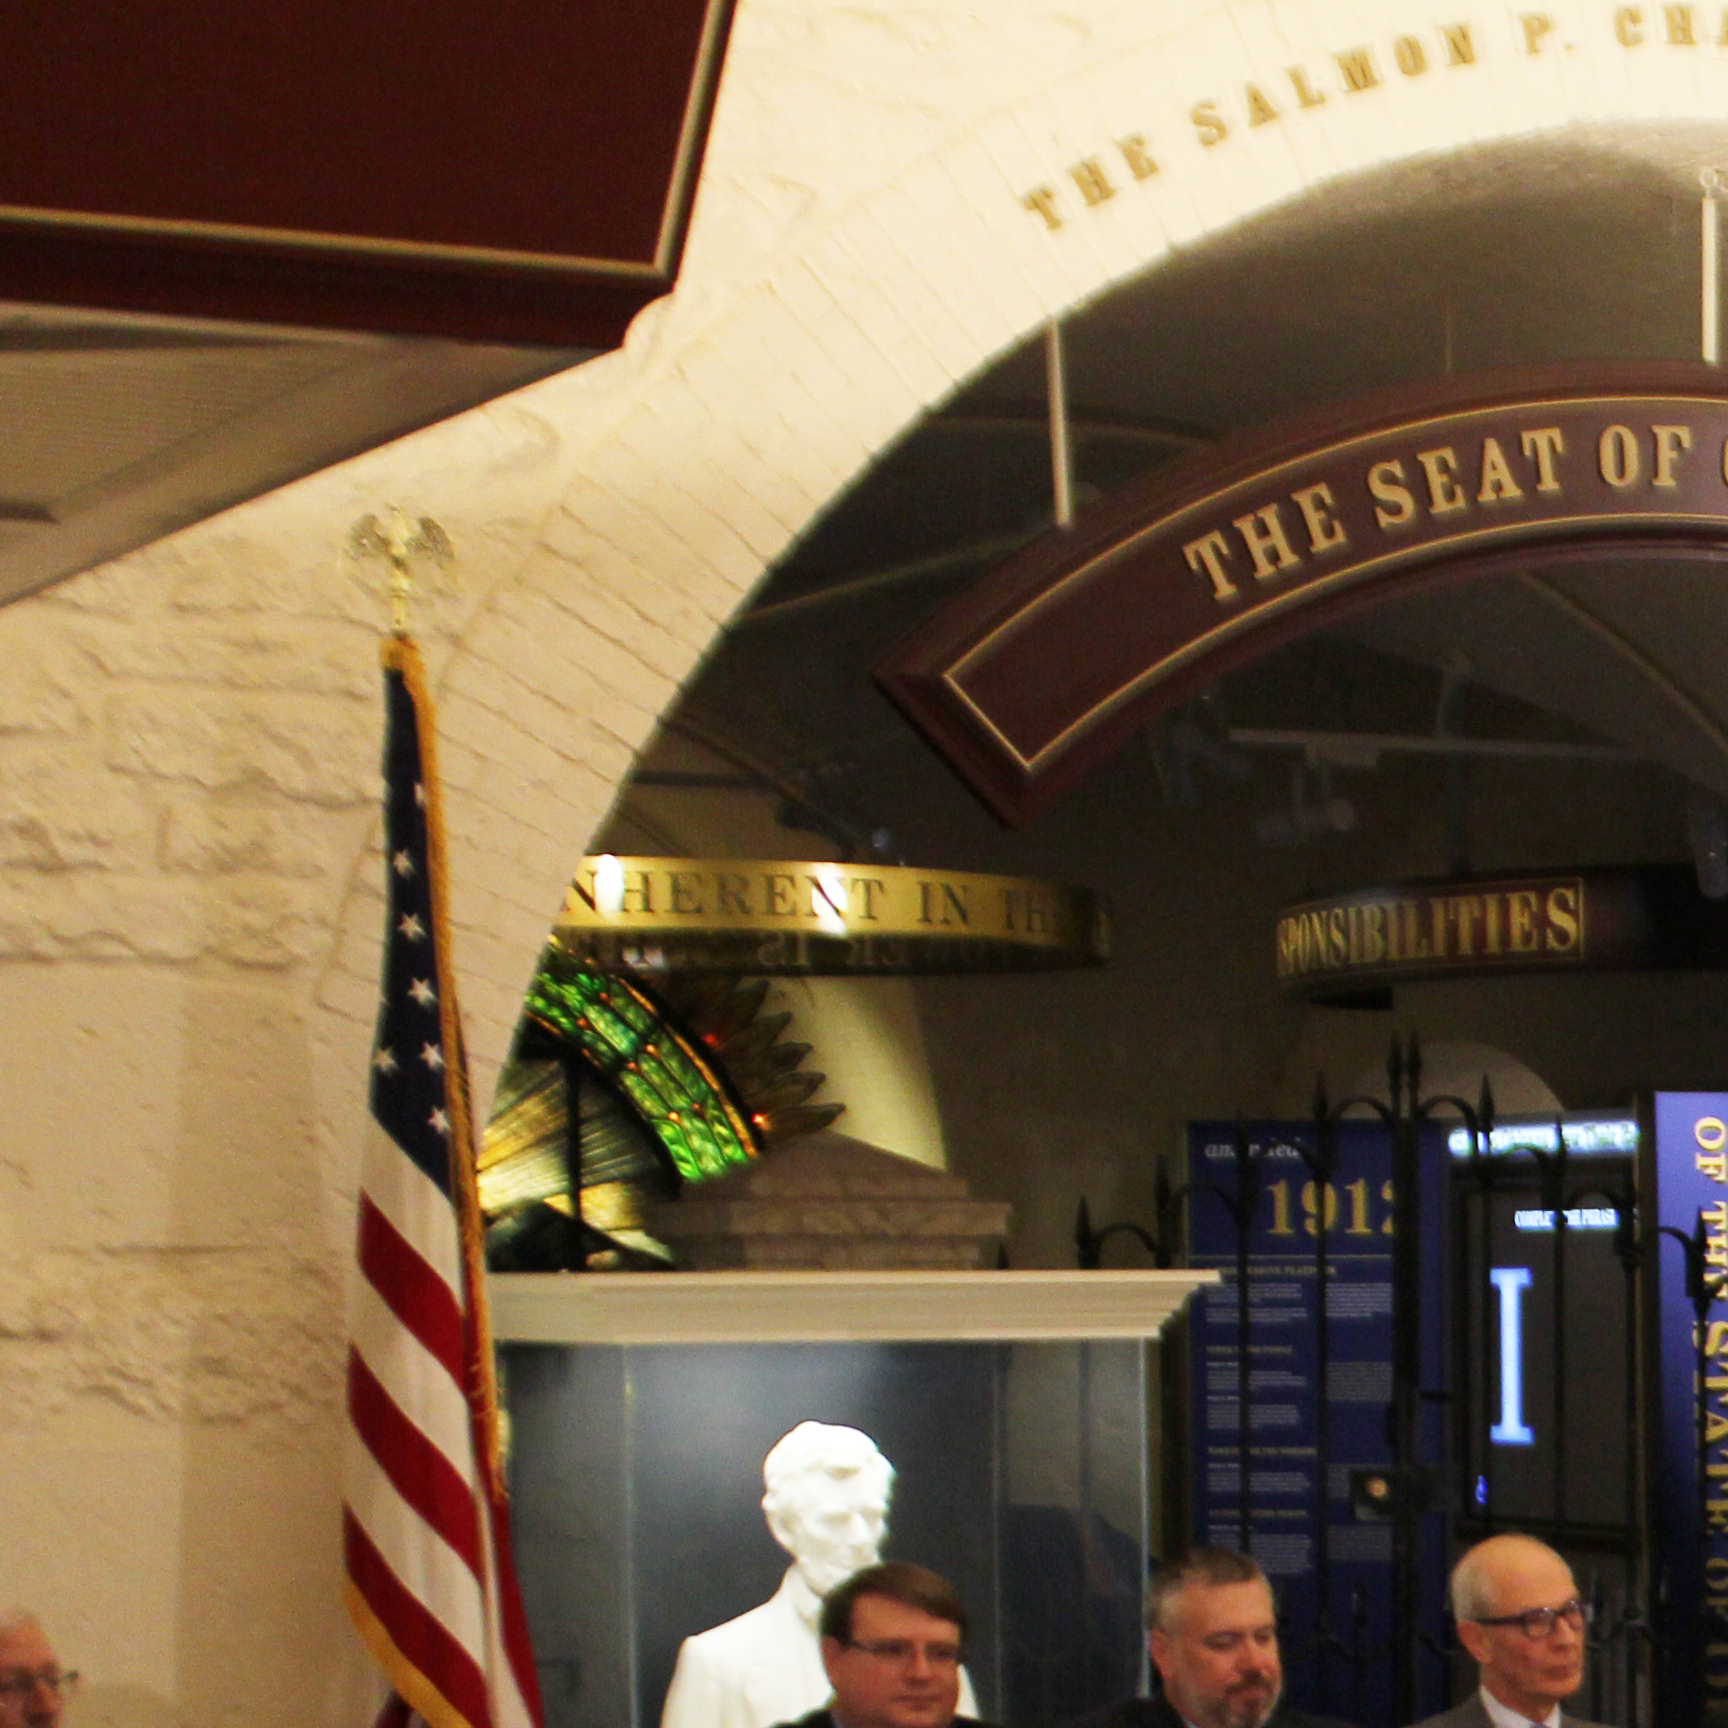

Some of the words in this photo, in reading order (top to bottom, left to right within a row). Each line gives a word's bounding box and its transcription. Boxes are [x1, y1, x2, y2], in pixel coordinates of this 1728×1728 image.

[1023, 133, 1160, 231] THE
[1188, 21, 1477, 149] SALMON
[1520, 12, 1574, 55] P.
[1181, 481, 1347, 602] THE
[1365, 425, 1565, 535] SEAT
[1598, 423, 1693, 489] OF
[565, 868, 884, 923] NHERENT
[916, 879, 970, 927] IN
[1694, 1115, 1728, 1184] OF
